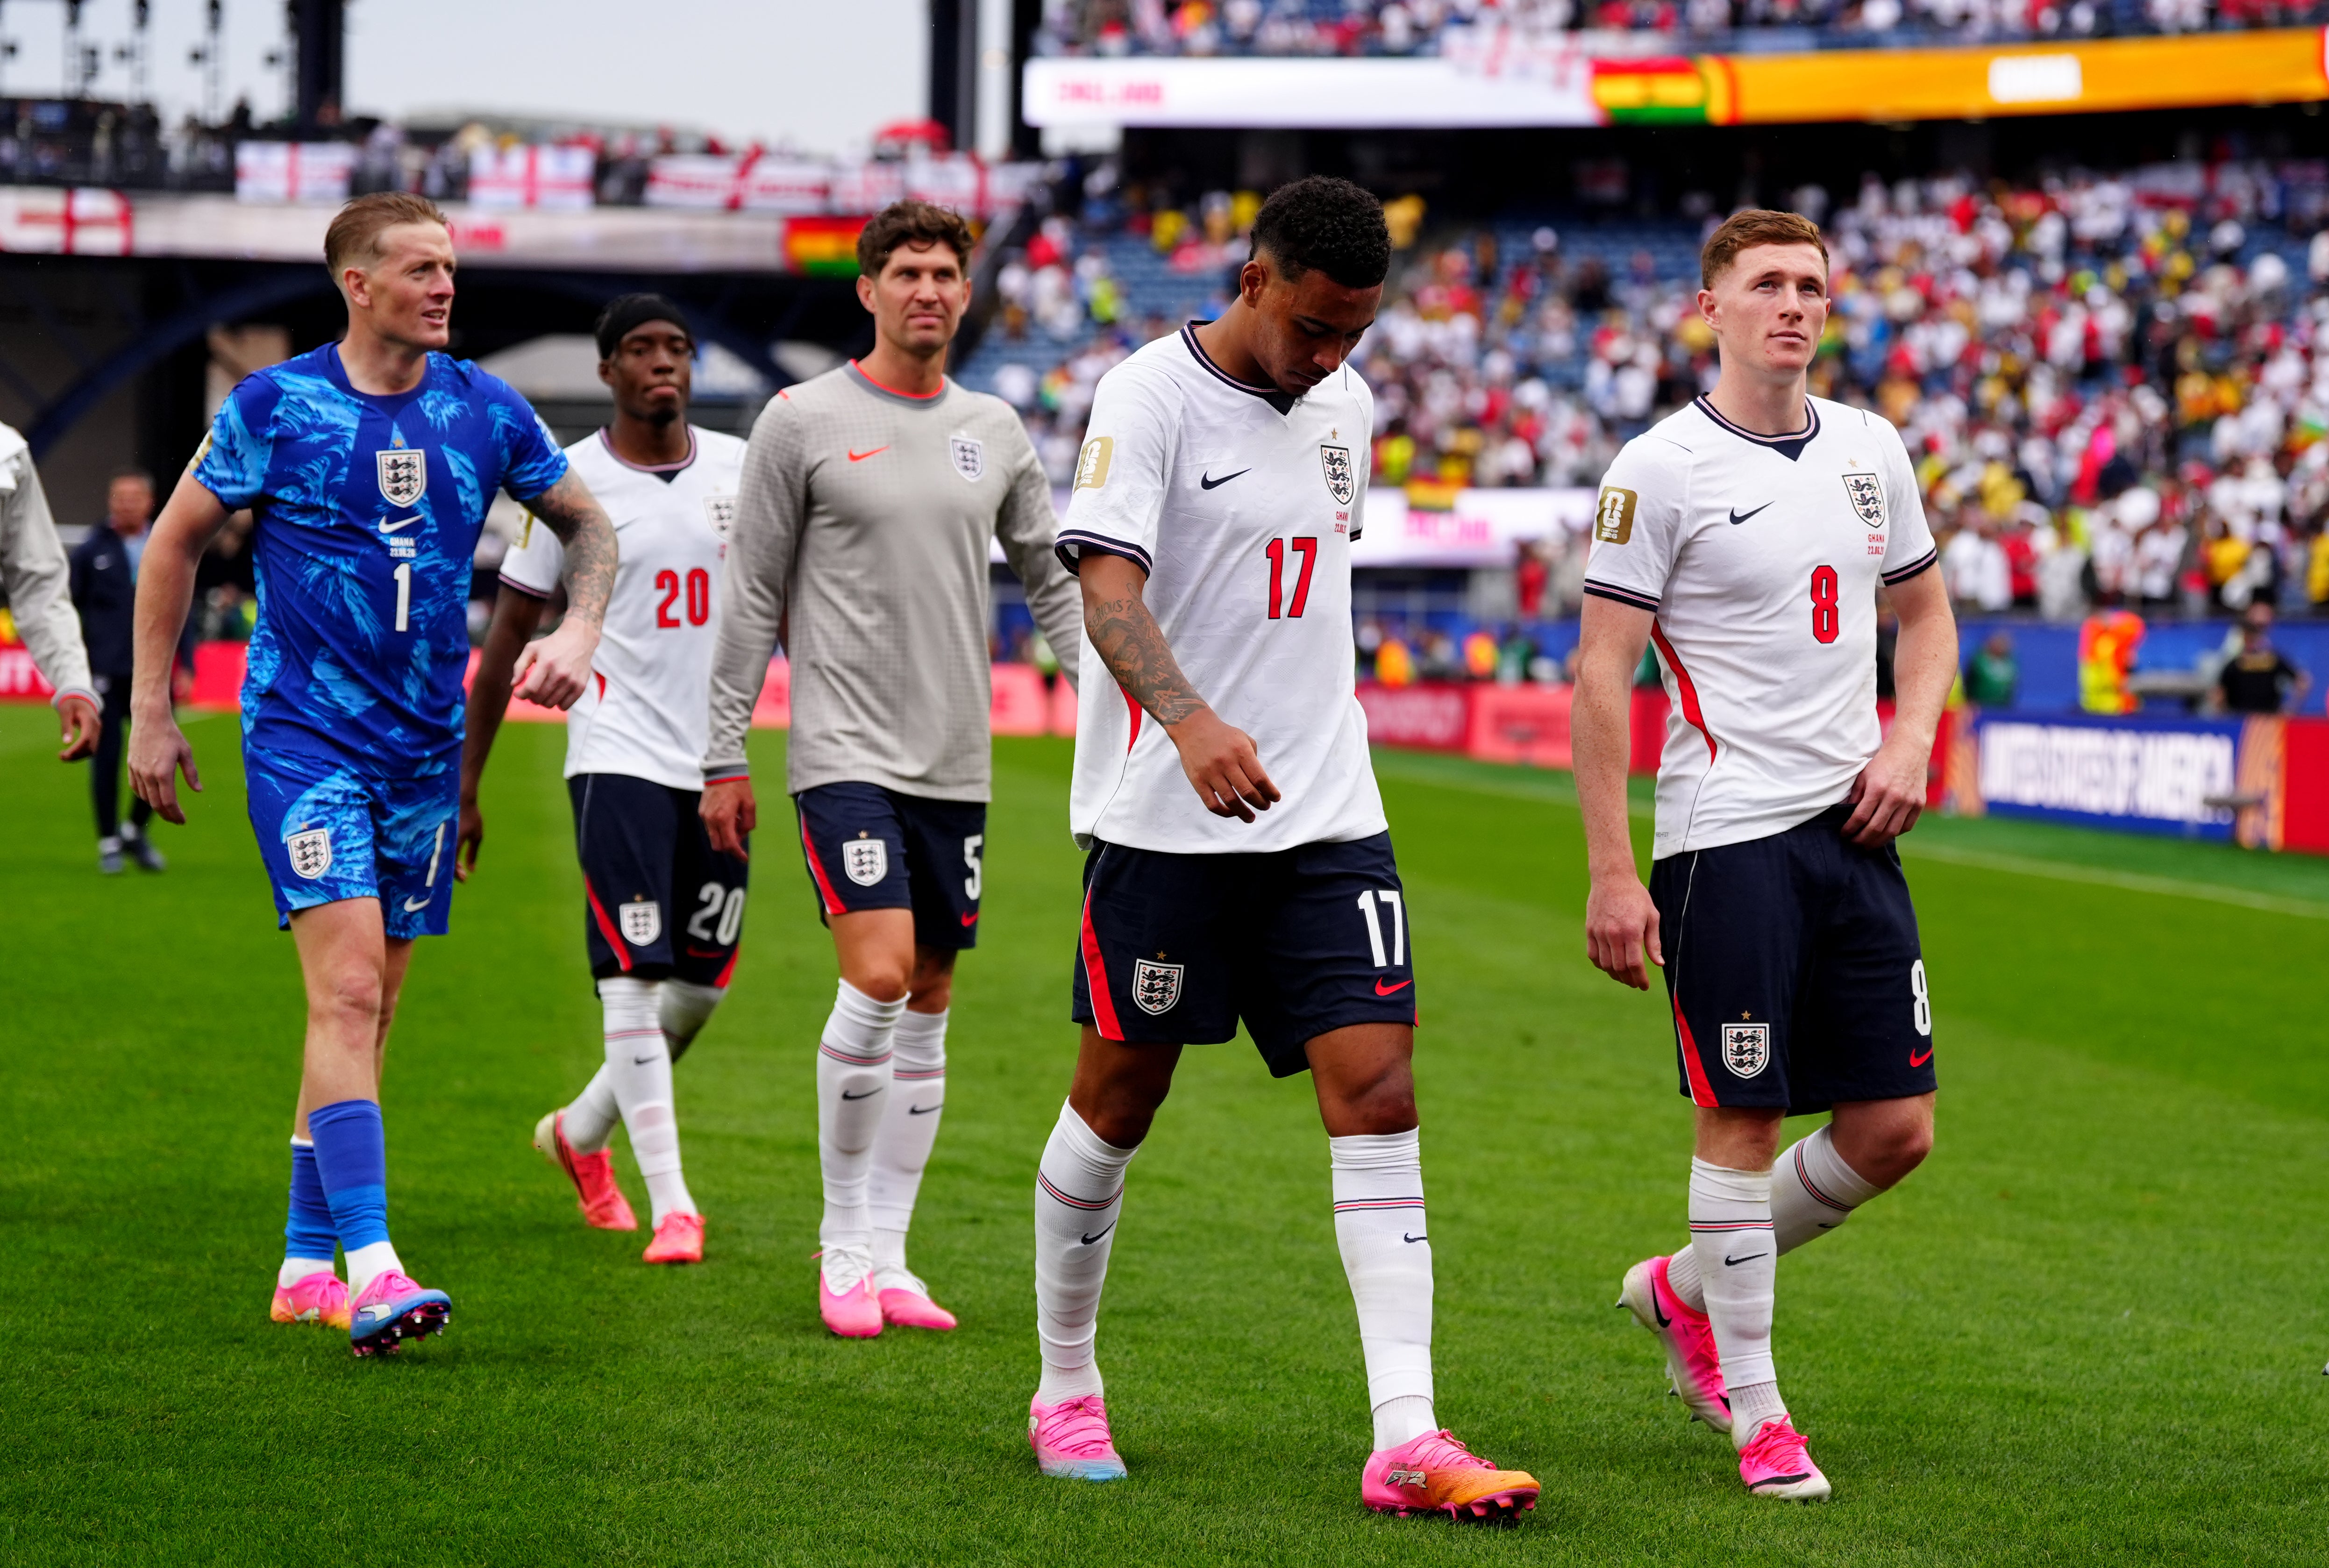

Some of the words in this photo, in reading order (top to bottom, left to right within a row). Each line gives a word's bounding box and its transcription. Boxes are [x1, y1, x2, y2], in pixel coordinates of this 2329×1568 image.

[390, 537, 415, 547] GHANA
[393, 563, 411, 632] 1
[655, 567, 709, 628] 20
[1266, 537, 1317, 619] 17
[1811, 565, 1839, 643] 8
[425, 821, 446, 887] 1
[964, 834, 983, 900] 5
[687, 881, 745, 946] 20
[1357, 890, 1404, 968] 17
[1911, 959, 1931, 1036] 8
